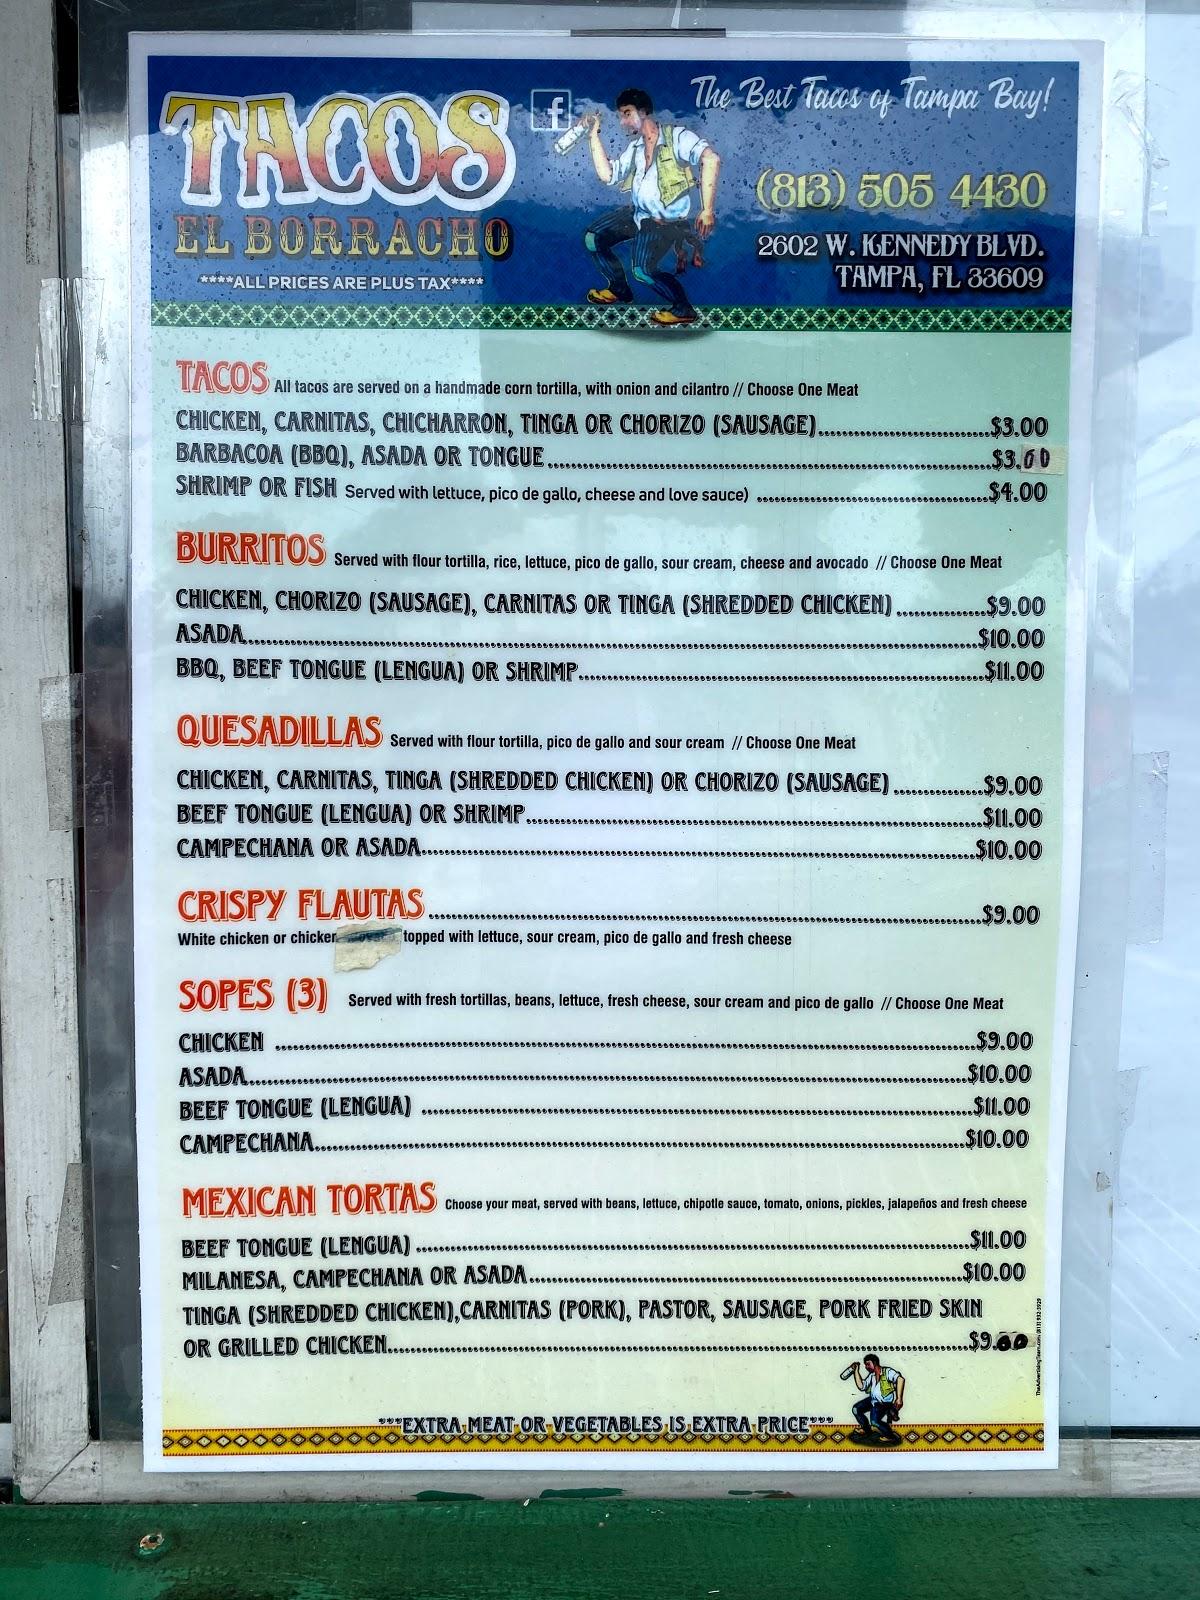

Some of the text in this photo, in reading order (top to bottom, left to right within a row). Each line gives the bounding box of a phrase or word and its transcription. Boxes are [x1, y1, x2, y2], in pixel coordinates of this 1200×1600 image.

[690, 75, 1055, 119] The Best Tacos of Tampa Bay!
[160, 91, 516, 211] TACOS
[756, 169, 1047, 209] (813) 505 4430
[174, 214, 514, 260] EL BORRACHO
[758, 234, 1045, 258] 2602 W. KENNEDY BLVD.
[269, 275, 329, 290] PRICES
[332, 275, 367, 290] ARE
[371, 275, 415, 290] PLUS
[835, 265, 1044, 293] TAMPA, FL 33609
[176, 359, 270, 395] TACOS
[176, 410, 1049, 440] CHICKEN, CARNITAS, CHICHARRON, TINGA OR CHORIZO (SAUSAGE) $3.00
[176, 442, 284, 464] BARBACOA
[291, 444, 354, 468] (BBQ),
[361, 445, 427, 466] ASADA
[434, 446, 462, 466] OR
[468, 446, 544, 467] TONGUE
[176, 475, 1048, 504] SHRIMP OR FISH $4.00
[176, 530, 327, 567] BURRITOS
[176, 589, 1046, 619] CHICKEN, CHORIZO (SAUSAGE), CARNITAS OR TINGA (SHREDDED CHICKEN) $9.00
[176, 623, 1046, 651] ASADA $10.00
[176, 658, 1046, 683] BBQ, BEEF TONGUE (LENGUA) OR SHRIMP $11.00
[177, 714, 384, 749] QUESADILLAS
[177, 803, 1043, 830] BEEF TONGUE (LENGUA) OR SHRIMP $11.00
[177, 887, 1041, 927] CRISPY FLAUTAS $9.00
[178, 933, 215, 945] White
[220, 932, 269, 945] chicken
[274, 934, 286, 944] or
[403, 930, 444, 945] topped
[449, 930, 473, 942] with
[478, 930, 522, 944] lettuce,
[527, 933, 553, 943] sour
[558, 933, 599, 945] cream,
[604, 931, 629, 946] pico
[634, 931, 648, 943] de
[652, 931, 681, 946] gallo
[686, 932, 708, 944] and
[712, 932, 743, 944] fresh
[748, 932, 791, 945] cheese
[178, 977, 329, 1014] SOPES (3)
[179, 1030, 1034, 1054] CHICKEN $9.00
[179, 1063, 1033, 1087] ASADA $10.00
[180, 1095, 1031, 1121] BEEF TONGUE (LENGUA) $11.00
[180, 1128, 1030, 1154] CAMPECHANA $10.00
[182, 1181, 1027, 1218] MEXICAN TORTAS Choose your meat, served with beans, lettuce, chipotle sauce, tomato, onions, pickles, jalapeños and fresh cheese
[182, 1229, 1027, 1259] BEEF TONGUE (LENGUA) $11.00
[182, 1262, 1027, 1291] MILANESA, CAMPECHANA OR ASADA $10.00
[182, 1306, 241, 1326] TINGA
[249, 1304, 359, 1326] (SHREDDED
[559, 1300, 631, 1323] (PORK),
[639, 1299, 716, 1323] PASTOR,
[723, 1299, 812, 1322] SAUSAGE,
[819, 1299, 871, 1318] PORK
[878, 1299, 933, 1318] FRIED
[940, 1299, 982, 1318] SKIN
[184, 1339, 212, 1358] OR
[218, 1337, 299, 1357] GRILLED
[306, 1335, 389, 1355] CHICKEN
[467, 1415, 514, 1434] MEAT
[521, 1415, 546, 1434] OR
[552, 1415, 662, 1434] VEGETABLES
[670, 1415, 686, 1433] IS
[692, 1415, 752, 1433] EXTRA
